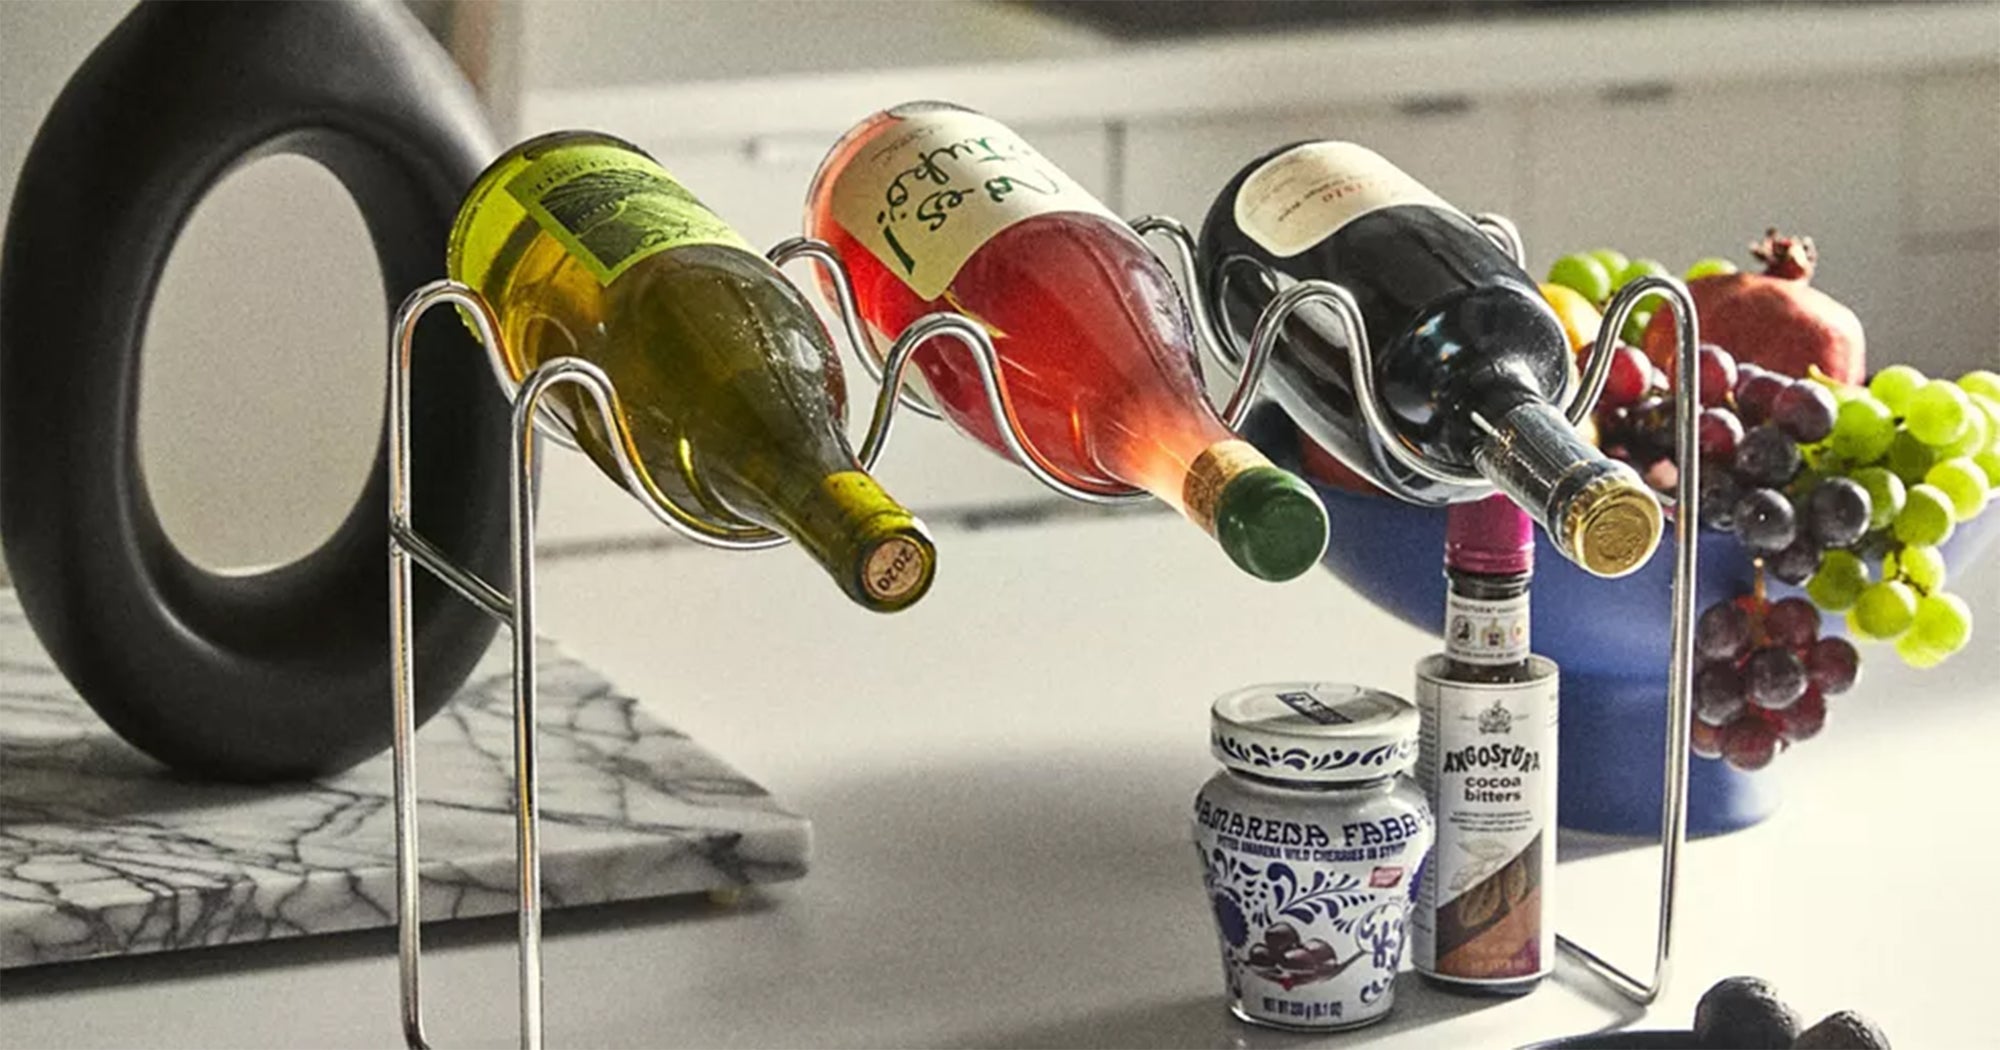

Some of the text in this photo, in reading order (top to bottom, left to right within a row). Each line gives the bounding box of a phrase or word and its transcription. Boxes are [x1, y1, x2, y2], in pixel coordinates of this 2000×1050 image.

[876, 547, 914, 592] 2020
[1443, 743, 1540, 773] ANGOSTURA
[1465, 777, 1521, 789] cocoa
[1465, 788, 1521, 802] bitters
